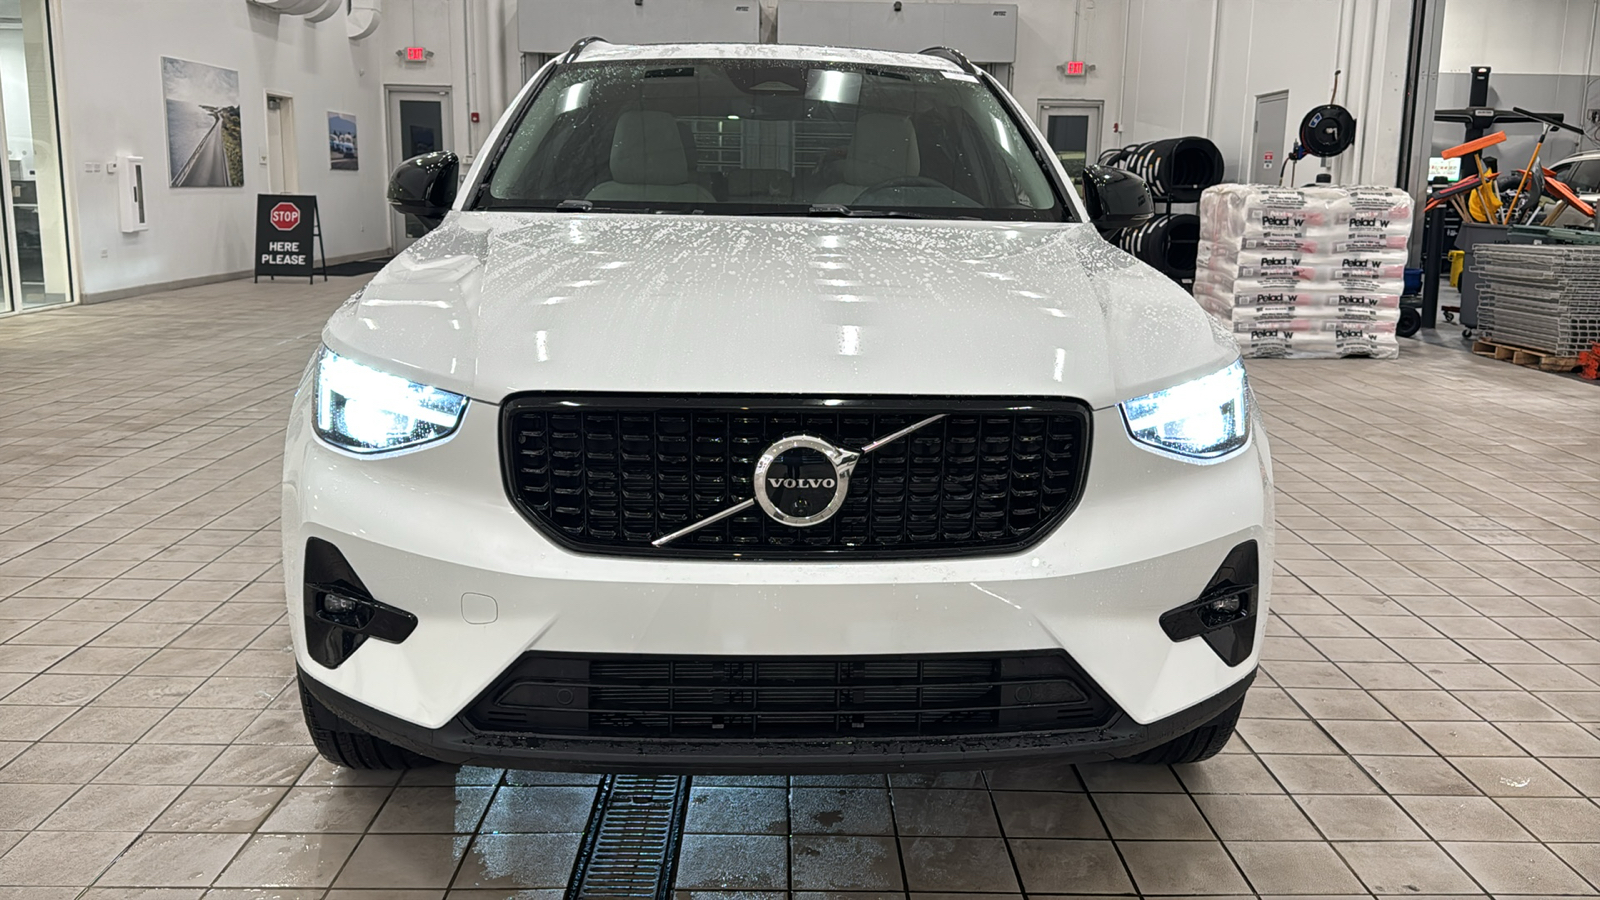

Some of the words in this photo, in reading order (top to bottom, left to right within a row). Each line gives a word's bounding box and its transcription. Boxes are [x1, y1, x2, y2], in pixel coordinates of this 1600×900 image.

[408, 48, 423, 60] EXIT
[1068, 61, 1083, 73] EXIT
[272, 211, 298, 222] STOP
[1262, 216, 1304, 227] Peladw
[1349, 218, 1390, 228] Peladw
[269, 241, 300, 252] HERE
[261, 254, 306, 265] PLEASE
[1261, 257, 1301, 266] Peladw
[1342, 259, 1382, 268] Peladw
[1257, 293, 1298, 302] Peladw
[1338, 295, 1378, 306] Peladw
[1251, 329, 1293, 339] Peladw
[768, 478, 836, 488] VOLVO
